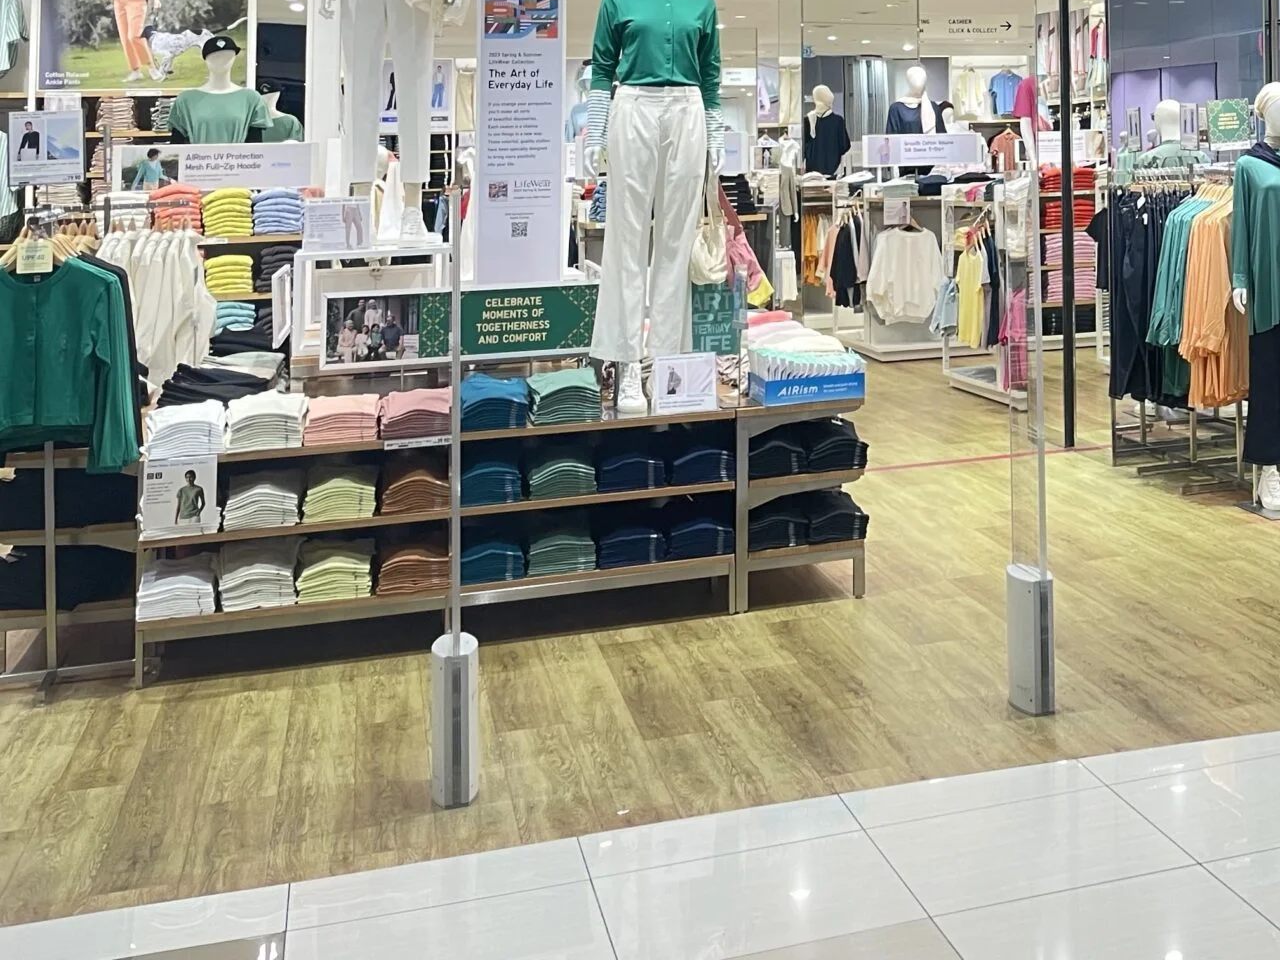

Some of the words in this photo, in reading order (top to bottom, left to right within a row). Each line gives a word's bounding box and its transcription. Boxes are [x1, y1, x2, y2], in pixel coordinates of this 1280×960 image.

[488, 69, 506, 78] The
[510, 69, 526, 77] Art
[530, 69, 539, 77] of
[488, 80, 531, 91] Everyday
[535, 80, 554, 88] Life
[185, 163, 204, 171] Mesh
[206, 163, 235, 171] Full-Zip
[515, 180, 551, 188] LifeWear
[485, 296, 542, 307] CELEBRATE
[482, 309, 528, 320] MOMENTS
[531, 308, 545, 317] OF
[476, 320, 550, 332] TOGETHERNESS
[478, 335, 499, 344] AND
[502, 332, 547, 343] COMFORT
[777, 385, 818, 397] AIRism
